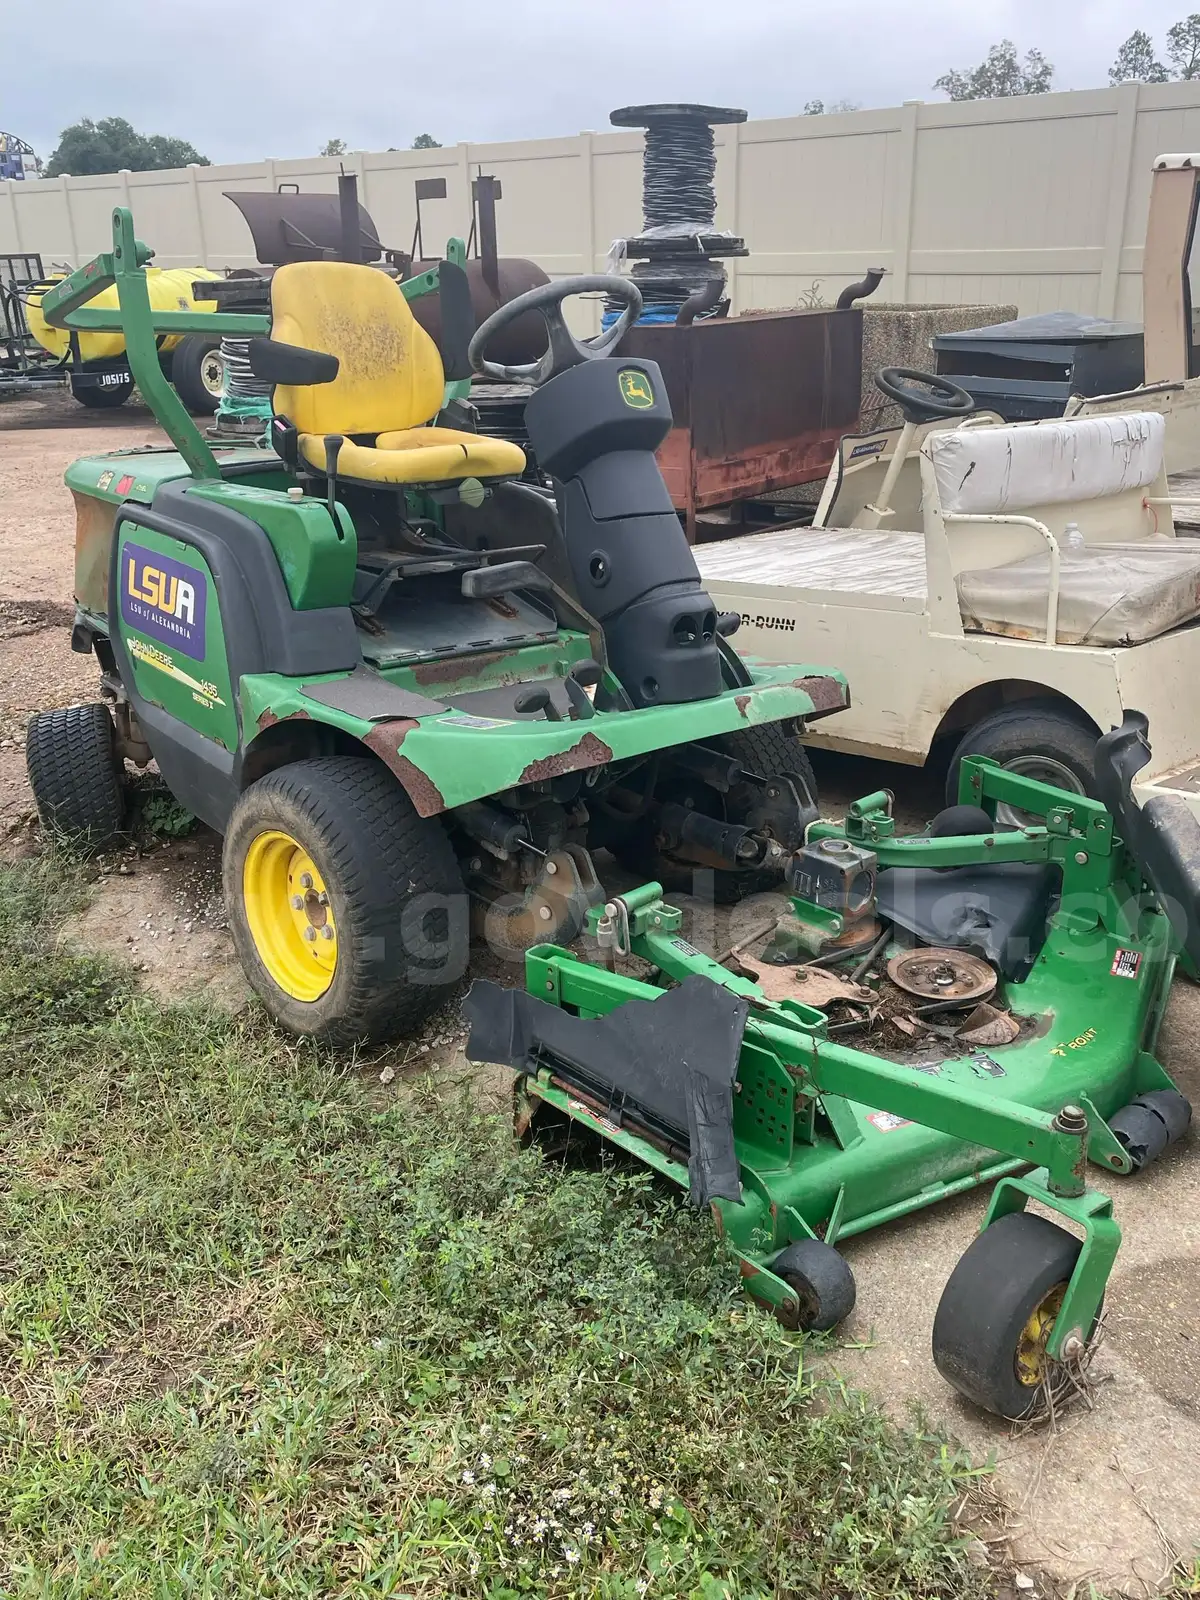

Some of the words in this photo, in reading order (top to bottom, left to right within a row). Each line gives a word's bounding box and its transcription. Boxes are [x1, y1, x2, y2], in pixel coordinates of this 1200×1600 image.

[99, 372, 130, 387] J05175
[128, 558, 195, 625] LSUA
[130, 602, 141, 614] LSU
[143, 609, 150, 620] of
[151, 612, 191, 640] ALEXANDRIA
[200, 679, 218, 699] 1435
